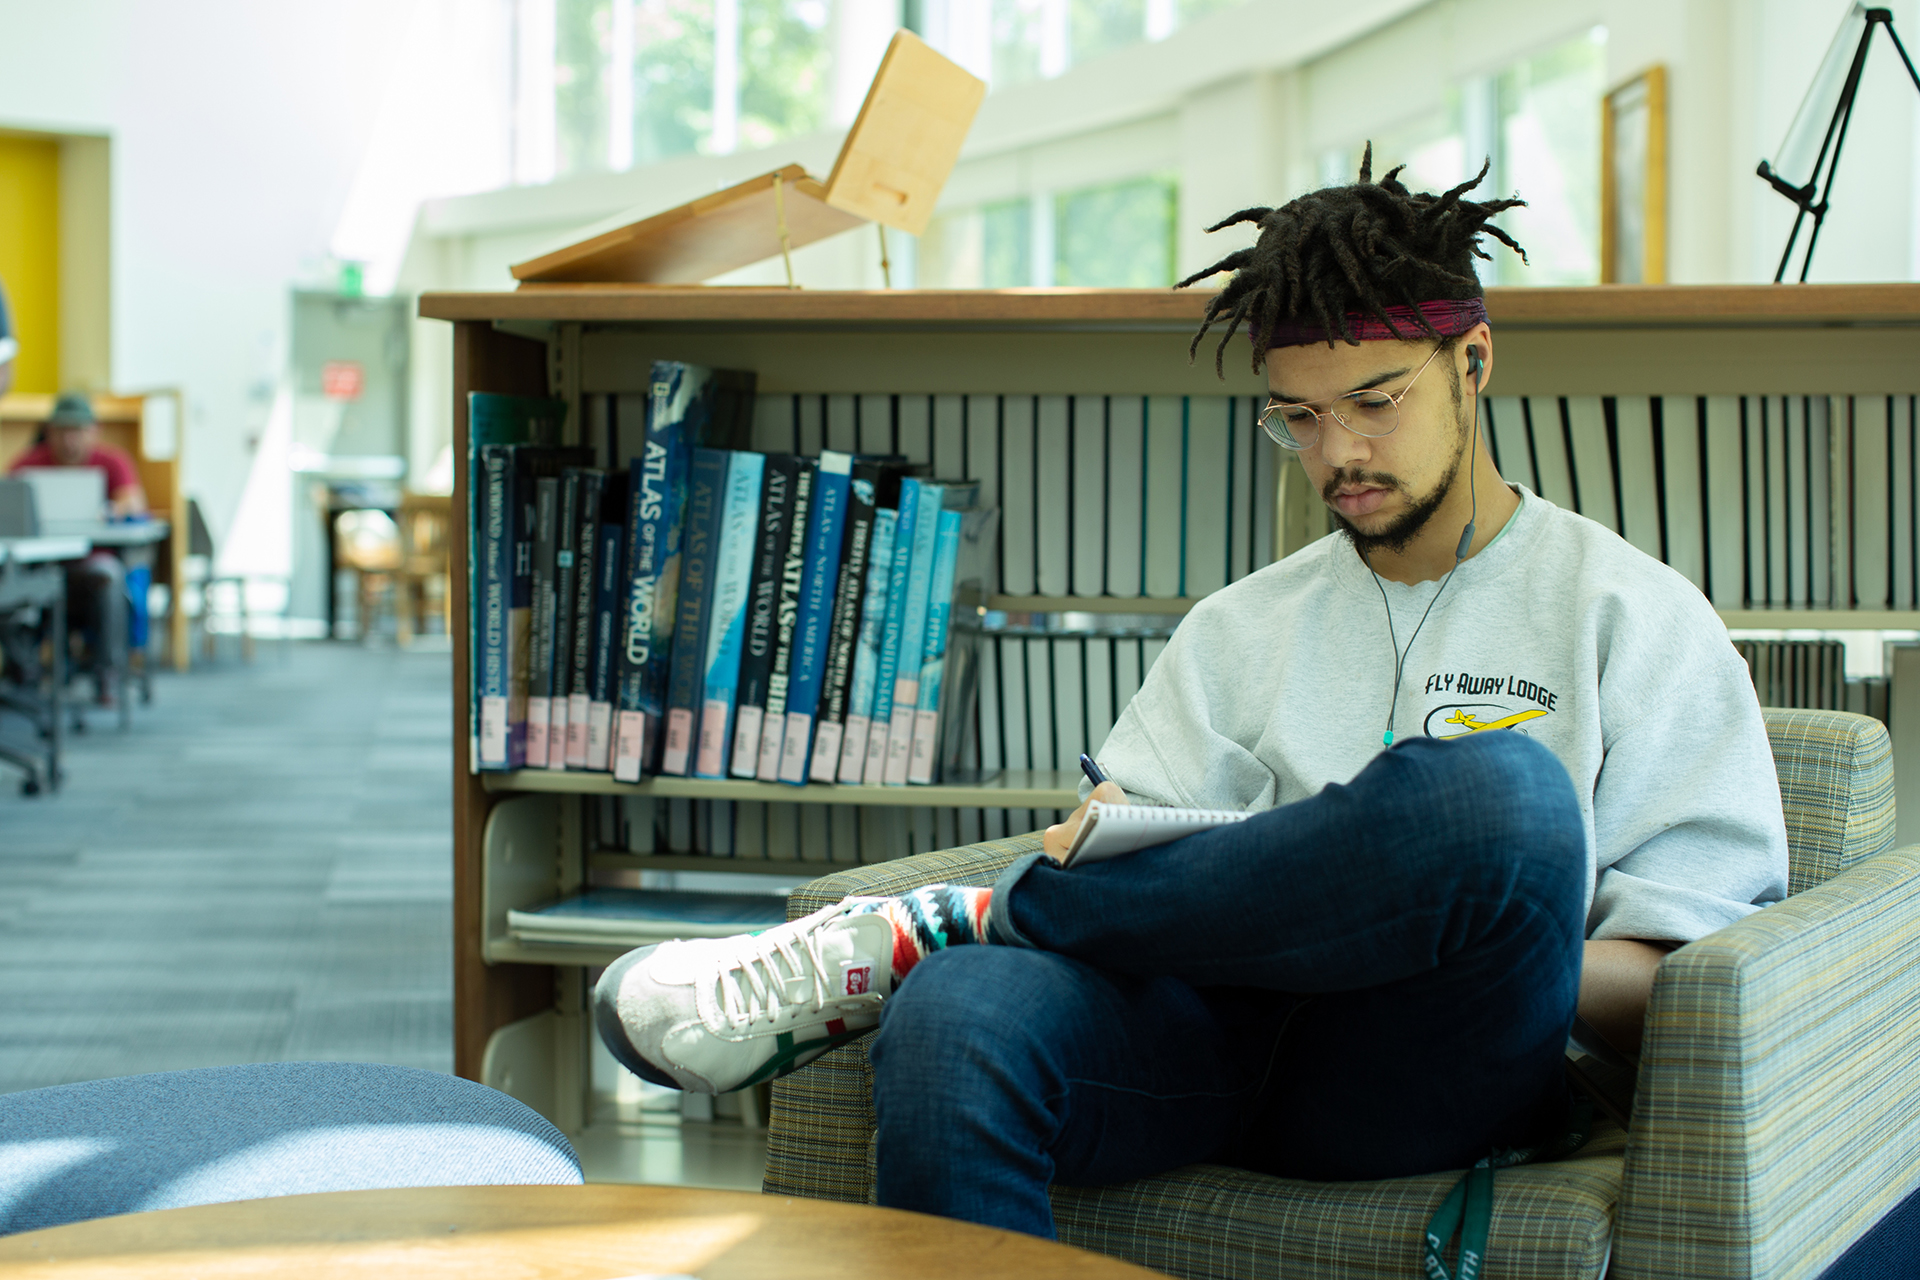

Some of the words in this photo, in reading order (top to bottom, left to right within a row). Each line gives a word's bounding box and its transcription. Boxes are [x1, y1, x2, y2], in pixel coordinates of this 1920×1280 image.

[488, 457, 503, 539] HAMMOND
[639, 440, 667, 521] ATLAS
[730, 469, 750, 535] ATLAS
[765, 468, 787, 533] ATLAS
[796, 470, 812, 500] THE
[641, 523, 656, 543] OF
[689, 481, 712, 555] ATLAS
[789, 501, 808, 557] HARPER
[821, 485, 836, 534] ATLAS
[638, 545, 654, 572] THE
[848, 520, 869, 575] FIREFLY
[892, 547, 908, 587] ATLAS
[686, 558, 705, 592] OF
[777, 553, 804, 627] ATLAS
[809, 556, 827, 611] NORTH
[843, 575, 860, 618] ATLAS
[486, 583, 502, 647] WORLD
[626, 574, 656, 665] WORLD
[680, 598, 702, 648] THE
[718, 580, 738, 656] WORLD
[749, 580, 775, 657] WORLD
[777, 626, 792, 643] OF
[840, 619, 855, 640] OF
[573, 616, 590, 669] WORLD
[773, 646, 789, 673] THE
[799, 614, 818, 682] AMERICA
[834, 641, 852, 687] NORTH
[880, 622, 899, 679] UNITED
[485, 648, 502, 696] HISTO
[766, 673, 789, 714] BIB
[1425, 673, 1454, 695] FLY
[1456, 673, 1504, 695] AWAY
[1507, 675, 1558, 712] LODGE
